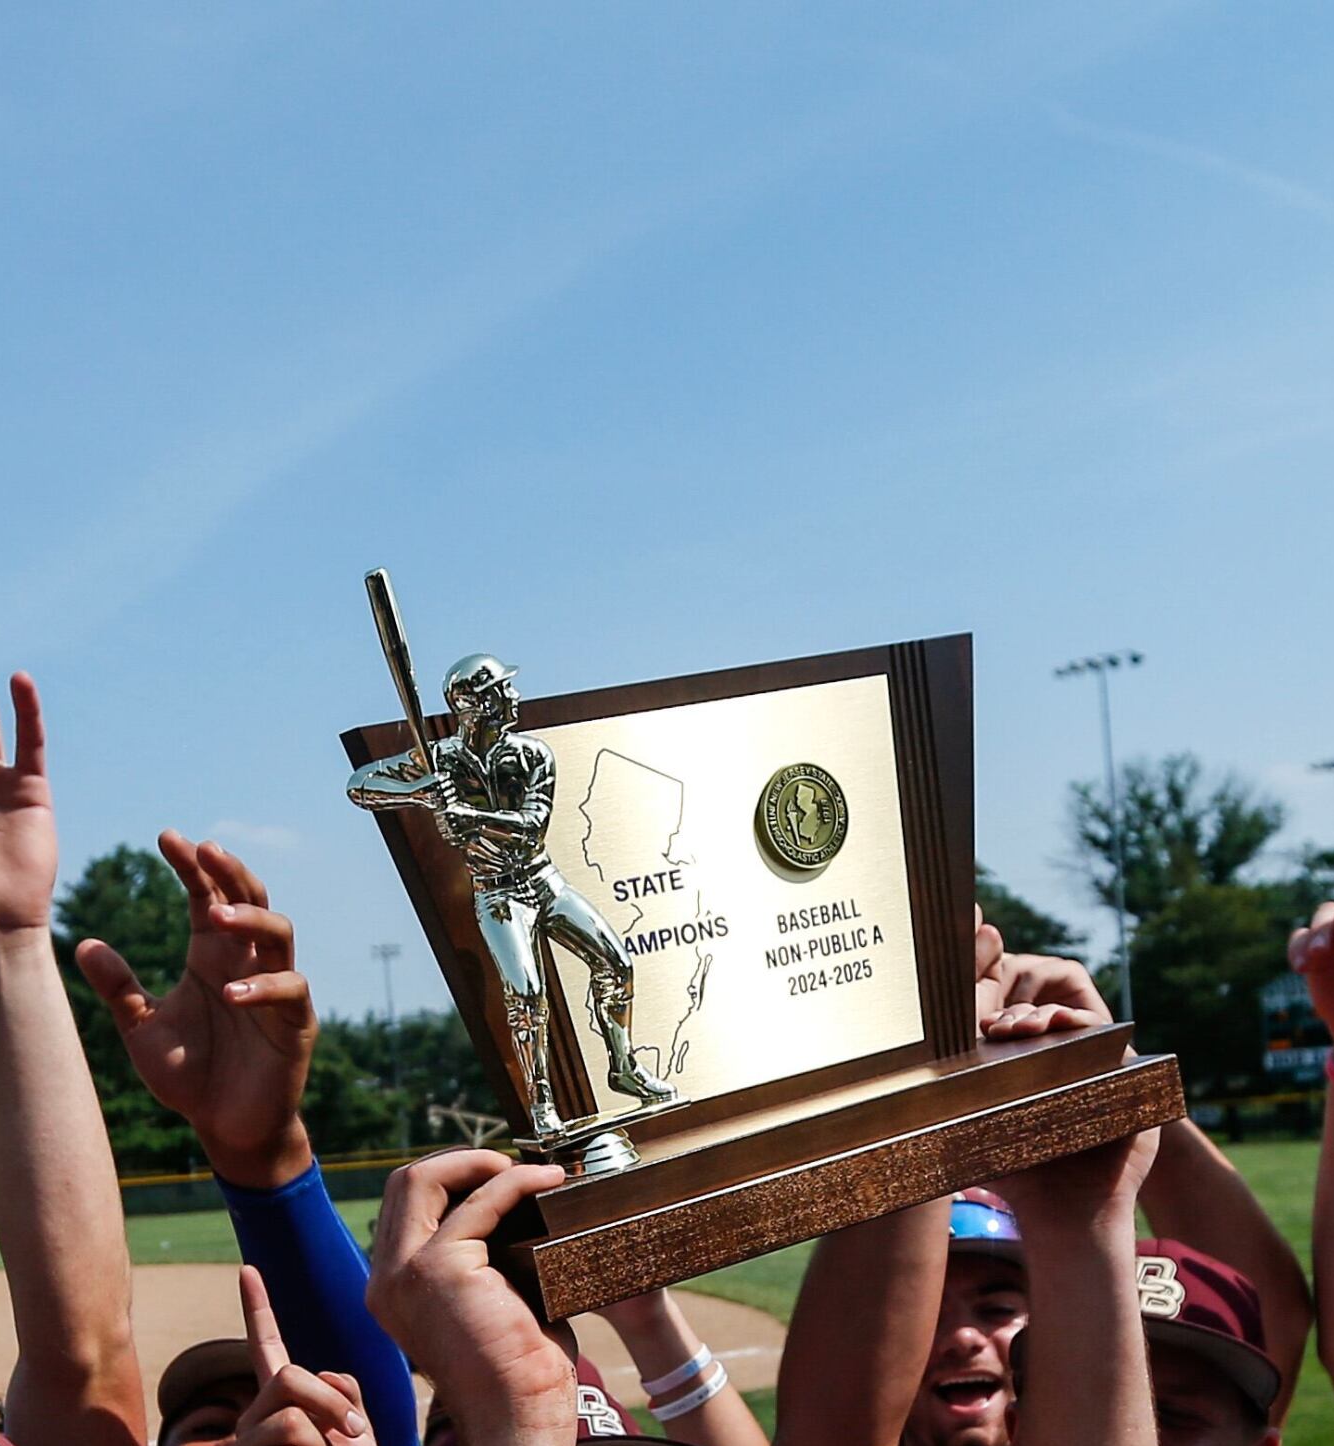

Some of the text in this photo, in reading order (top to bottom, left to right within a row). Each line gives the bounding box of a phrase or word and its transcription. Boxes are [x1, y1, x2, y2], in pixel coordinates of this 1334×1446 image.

[769, 782, 783, 803] NEW
[782, 766, 810, 784] JERSEY
[613, 869, 684, 902] STATE
[777, 898, 862, 934] BASEBALL
[623, 916, 729, 956] AMPIONS
[765, 925, 884, 969] NON-PUBLIC A
[788, 958, 873, 996] 2024-2025
